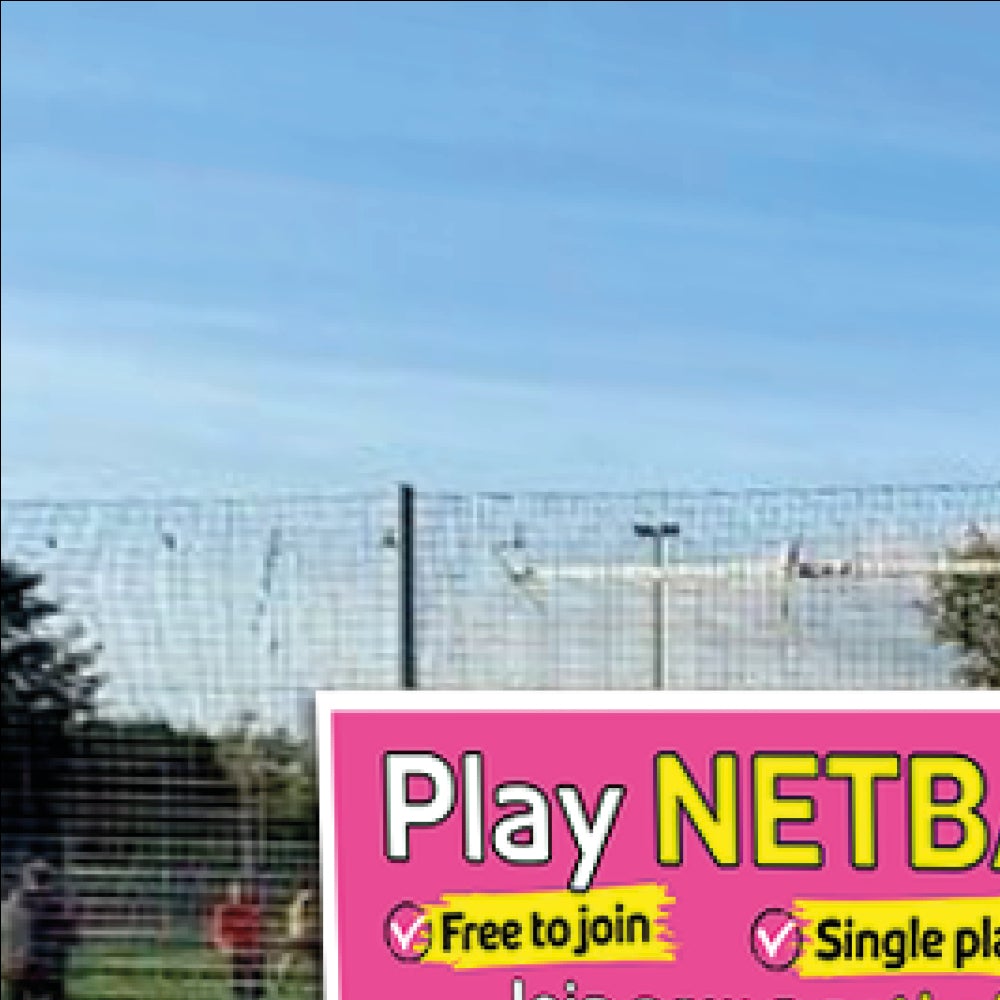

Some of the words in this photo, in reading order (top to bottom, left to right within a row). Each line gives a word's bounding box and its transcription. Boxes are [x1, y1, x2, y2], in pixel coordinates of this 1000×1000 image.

[383, 751, 626, 892] Play
[440, 911, 522, 952] Free
[531, 911, 569, 948] to
[571, 904, 650, 954] join
[815, 917, 944, 969] Single
